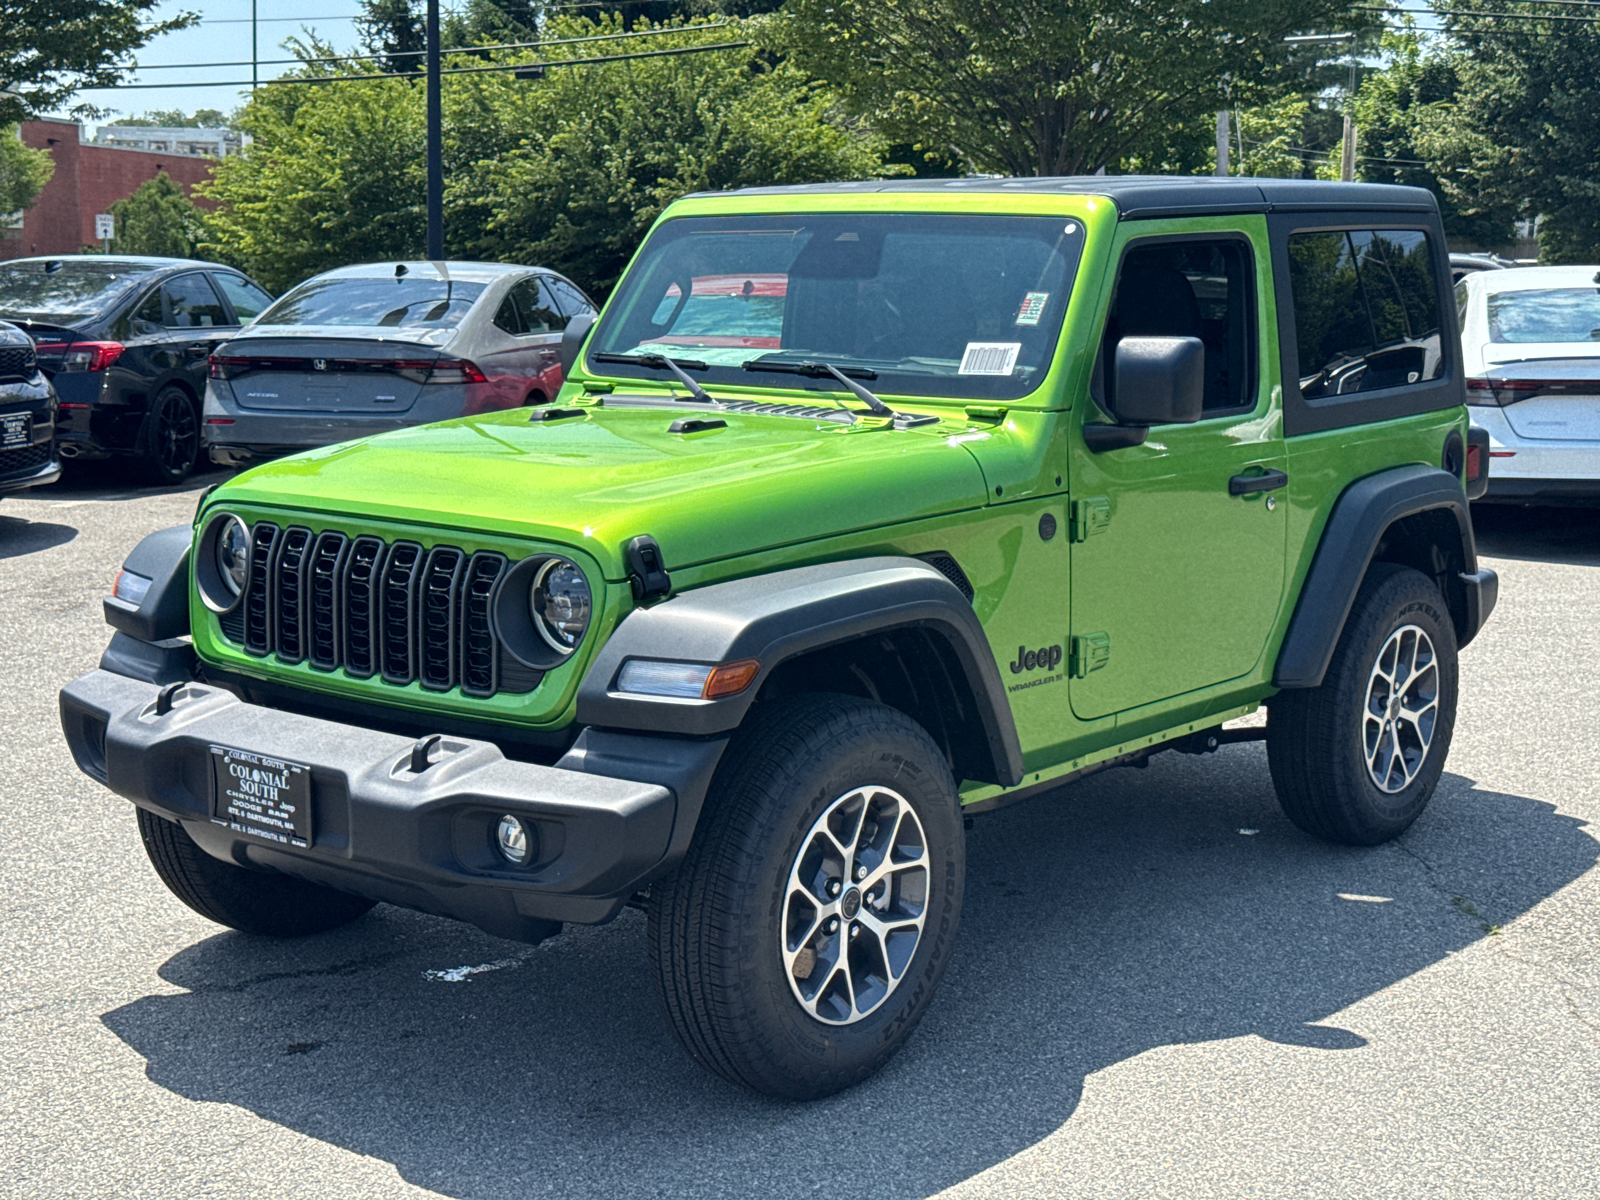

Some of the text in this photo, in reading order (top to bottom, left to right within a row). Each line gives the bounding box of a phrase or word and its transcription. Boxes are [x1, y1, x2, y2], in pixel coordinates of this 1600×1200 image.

[1398, 601, 1442, 623] NEXEN
[1010, 644, 1062, 674] Jeep
[1008, 675, 1055, 693] WRANGLER
[262, 758, 286, 770] SOUTH
[229, 763, 290, 790] COLONIAL
[239, 779, 279, 801] SOUTH
[226, 789, 296, 814] CHRYSLER Jeep
[231, 798, 289, 819] DODGE RAM
[284, 821, 295, 830] MA
